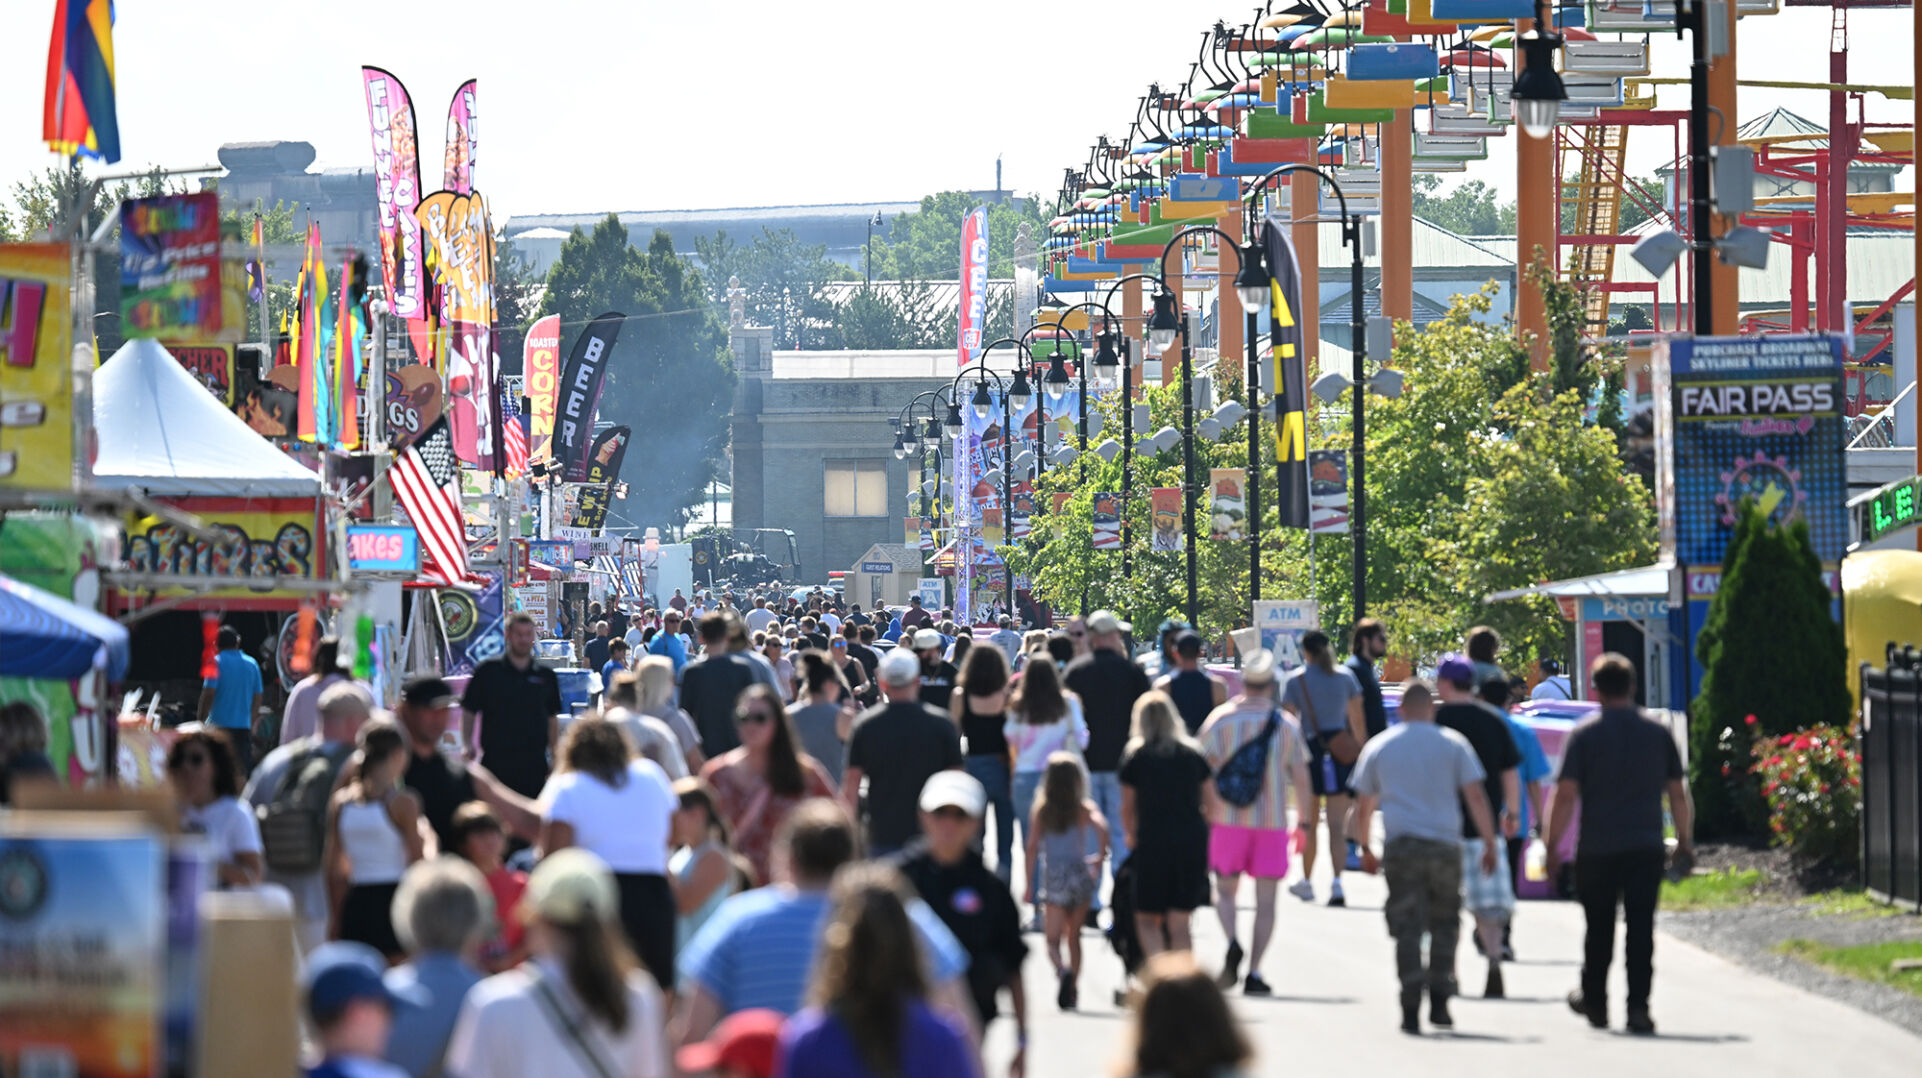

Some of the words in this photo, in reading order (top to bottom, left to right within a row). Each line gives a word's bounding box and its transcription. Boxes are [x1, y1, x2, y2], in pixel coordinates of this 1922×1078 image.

[368, 78, 395, 228] FUNNEL
[393, 178, 419, 314] CAKES
[968, 210, 989, 319] ICEE
[168, 348, 229, 388] CHER
[1692, 343, 1758, 357] PURCHASE
[531, 349, 555, 436] CORN
[561, 335, 605, 448] BEER
[1681, 385, 1748, 416] FAIR
[1751, 382, 1834, 414] PASS
[356, 394, 419, 433] DGS
[561, 529, 589, 539] WINE
[1268, 607, 1302, 620] ATM
